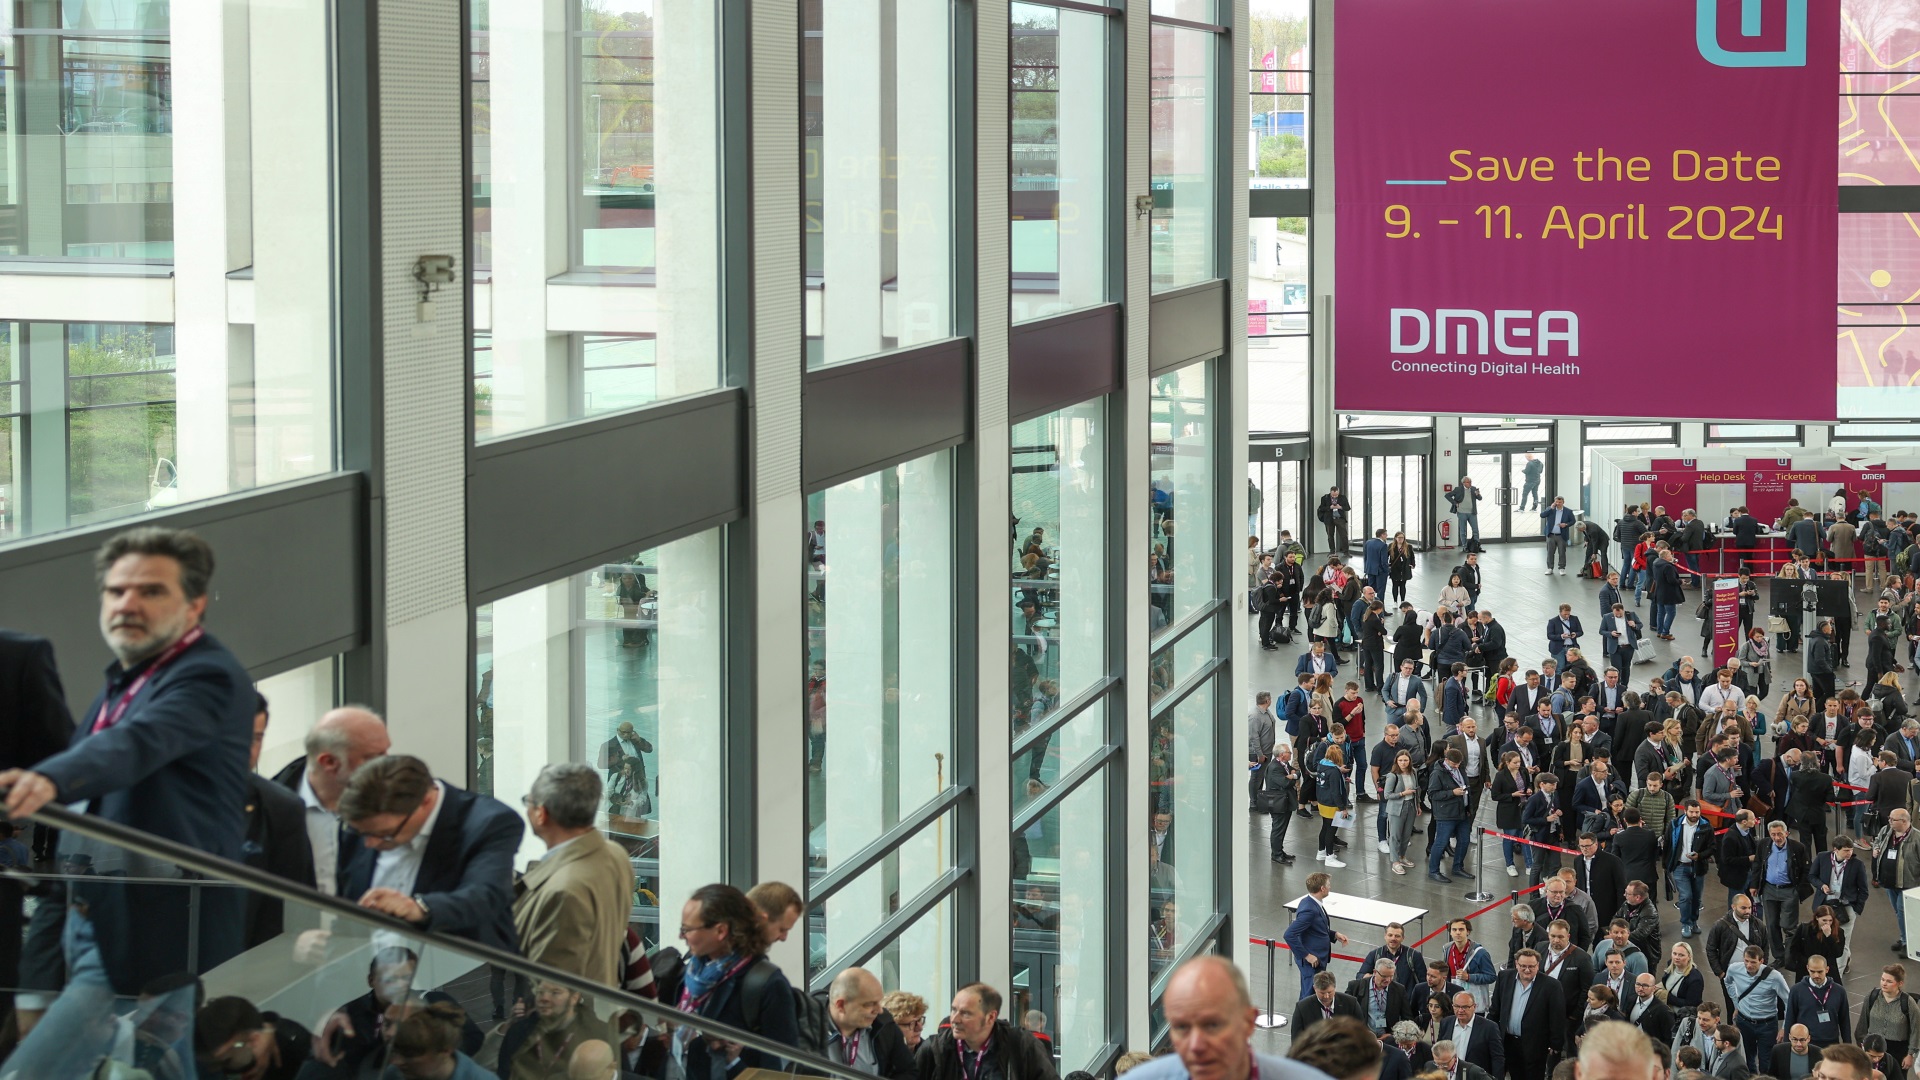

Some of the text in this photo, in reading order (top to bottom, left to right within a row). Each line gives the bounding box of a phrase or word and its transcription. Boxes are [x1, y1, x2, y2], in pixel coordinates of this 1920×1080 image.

[1572, 147, 1651, 182] the
[1672, 149, 1781, 182] Date
[1384, 204, 1421, 239] 9.
[1475, 205, 1523, 239] 11.
[1541, 203, 1650, 249] April
[1667, 205, 1783, 241] 2024
[1390, 308, 1579, 357] DMEA
[1391, 359, 1580, 377] Connecting Digital Health
[1275, 447, 1284, 458] B
[1723, 473, 1746, 481] Desk
[1776, 473, 1817, 483] Ticketing
